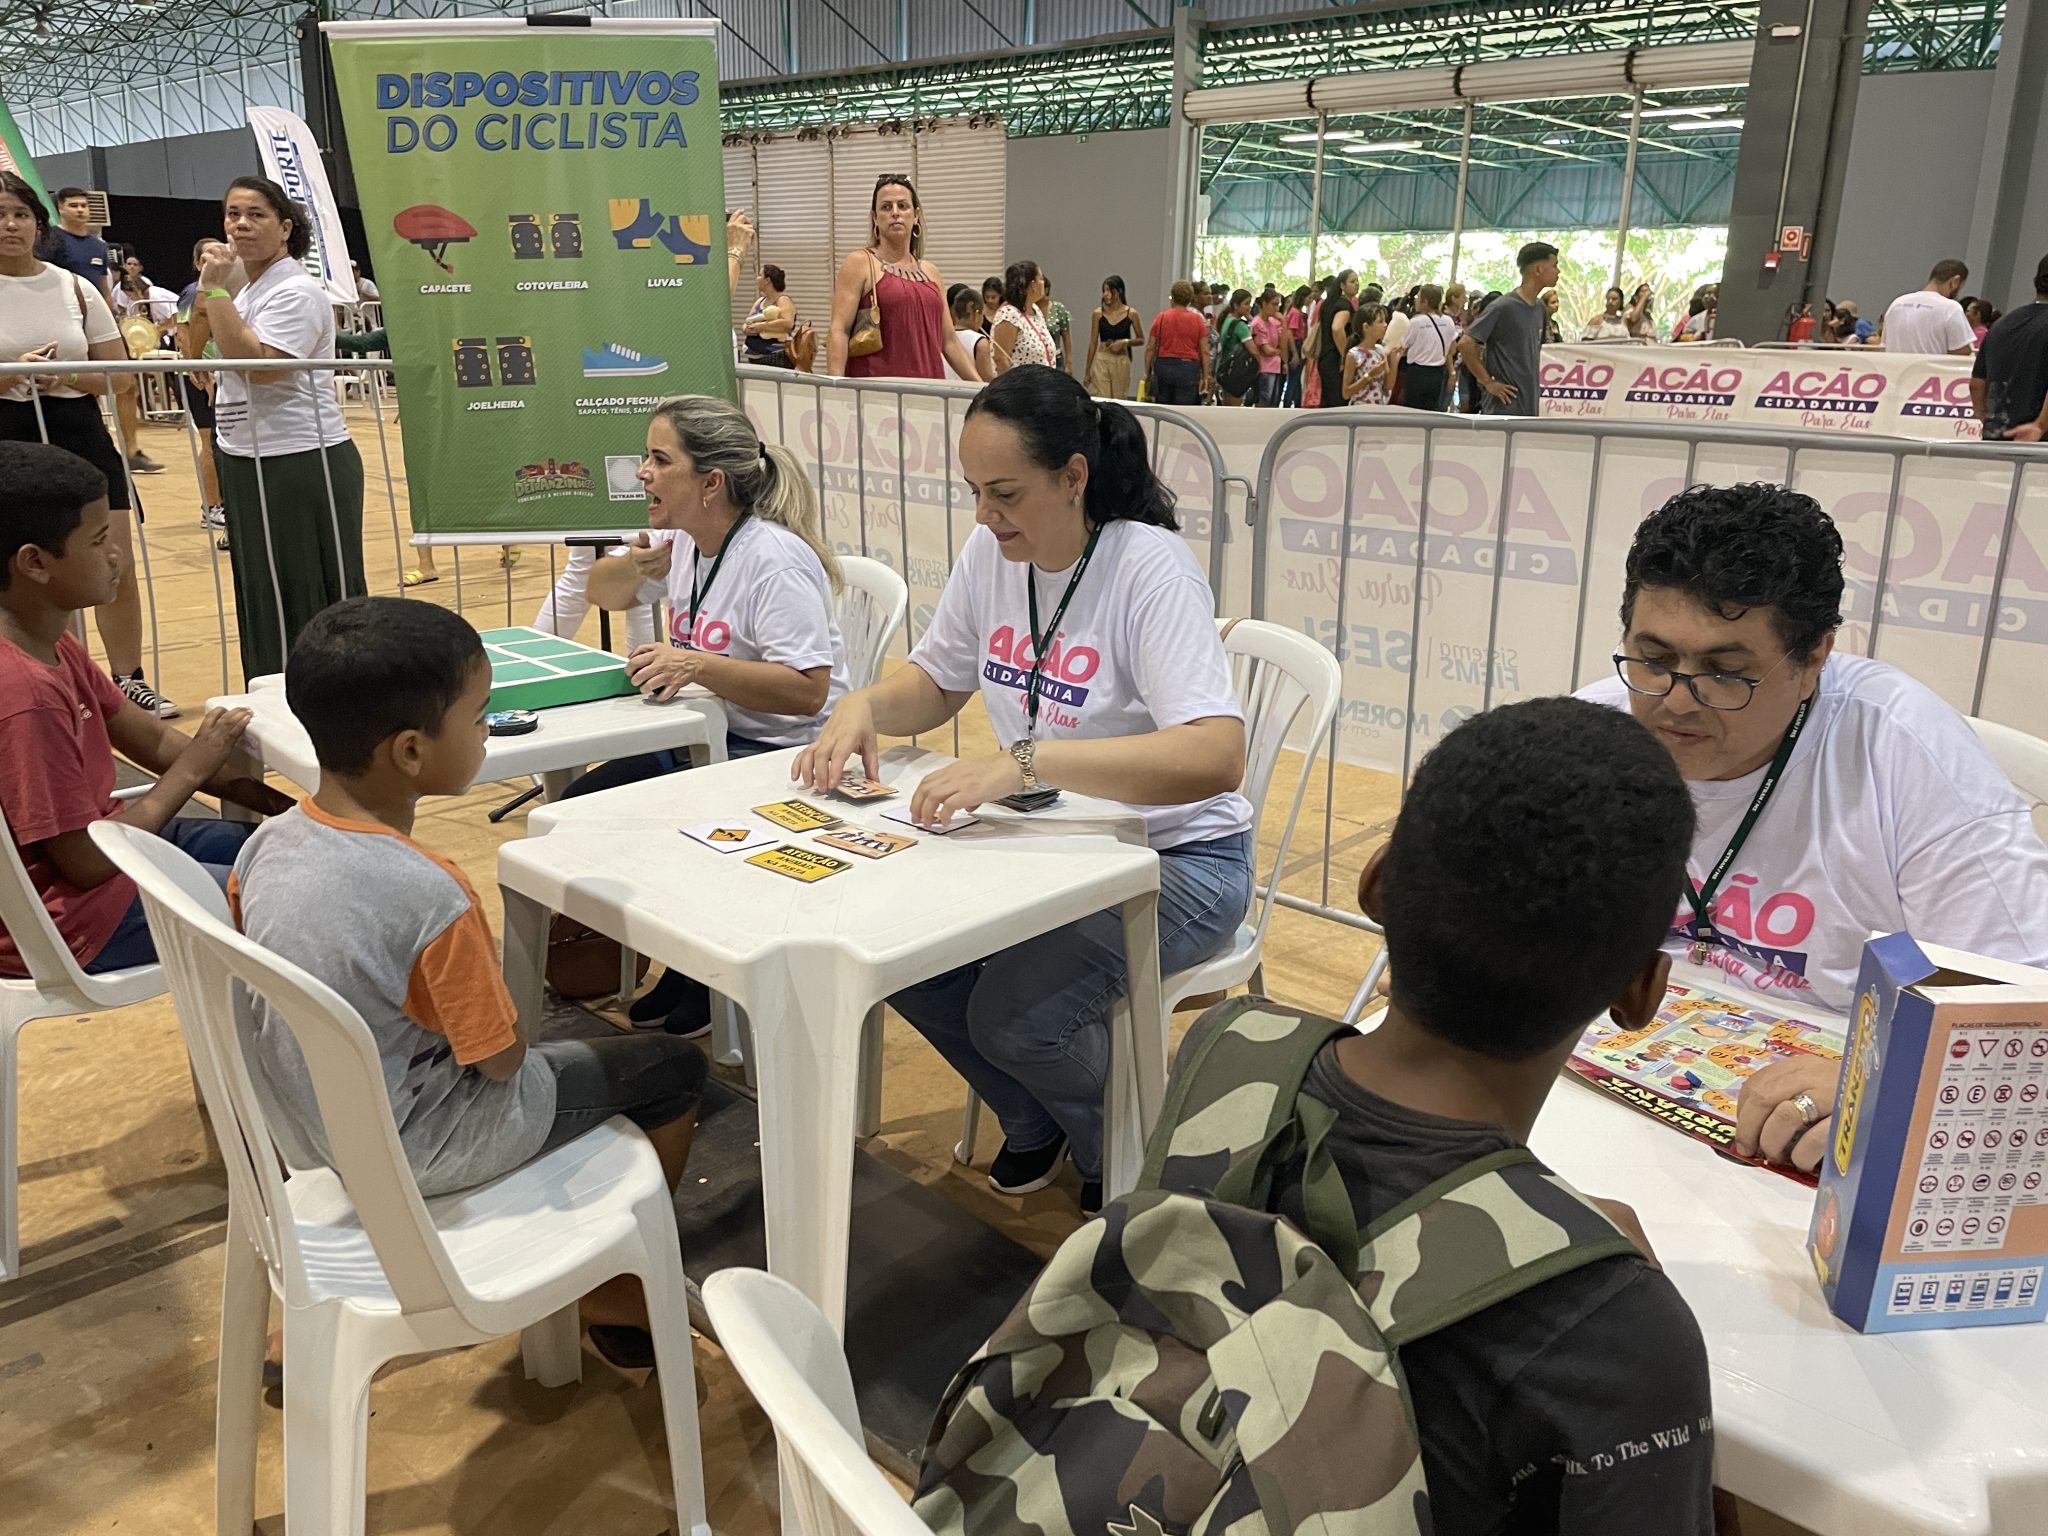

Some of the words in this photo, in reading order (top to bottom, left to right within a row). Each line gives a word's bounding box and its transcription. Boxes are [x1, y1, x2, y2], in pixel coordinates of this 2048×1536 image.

[376, 71, 700, 109] DISPOSITIVOS
[387, 113, 458, 153] DO
[475, 112, 688, 151] CICLISTA
[420, 284, 472, 294] CAPACETE
[516, 280, 589, 291] COTOVELEIRA
[647, 278, 683, 288] LUVAS
[1539, 360, 1614, 388] ÇÃO
[1630, 363, 1742, 393] AÇÃO
[1760, 367, 1887, 399] AÇÃO
[1542, 388, 1599, 400] ADANIA
[1633, 392, 1726, 405] CIDADANIA
[1908, 376, 1974, 406] AÇ
[467, 400, 525, 411] JOELHEIRA
[575, 397, 625, 407] CALÇADO
[1545, 399, 1573, 415] Para
[1764, 398, 1867, 412] CIDADANIA
[578, 408, 609, 416] SAPATO,
[1667, 404, 1697, 420] Para
[1912, 404, 1975, 418] CIDAD
[1800, 411, 1835, 428] Para
[988, 625, 1100, 683] AÇÃO
[778, 855, 816, 870] ANIMAIS
[782, 848, 838, 868] ATENÇÃO
[780, 864, 807, 875] PISTA
[1591, 1453, 1614, 1472] To
[1616, 1440, 1649, 1461] The
[1652, 1425, 1690, 1450] Wild
